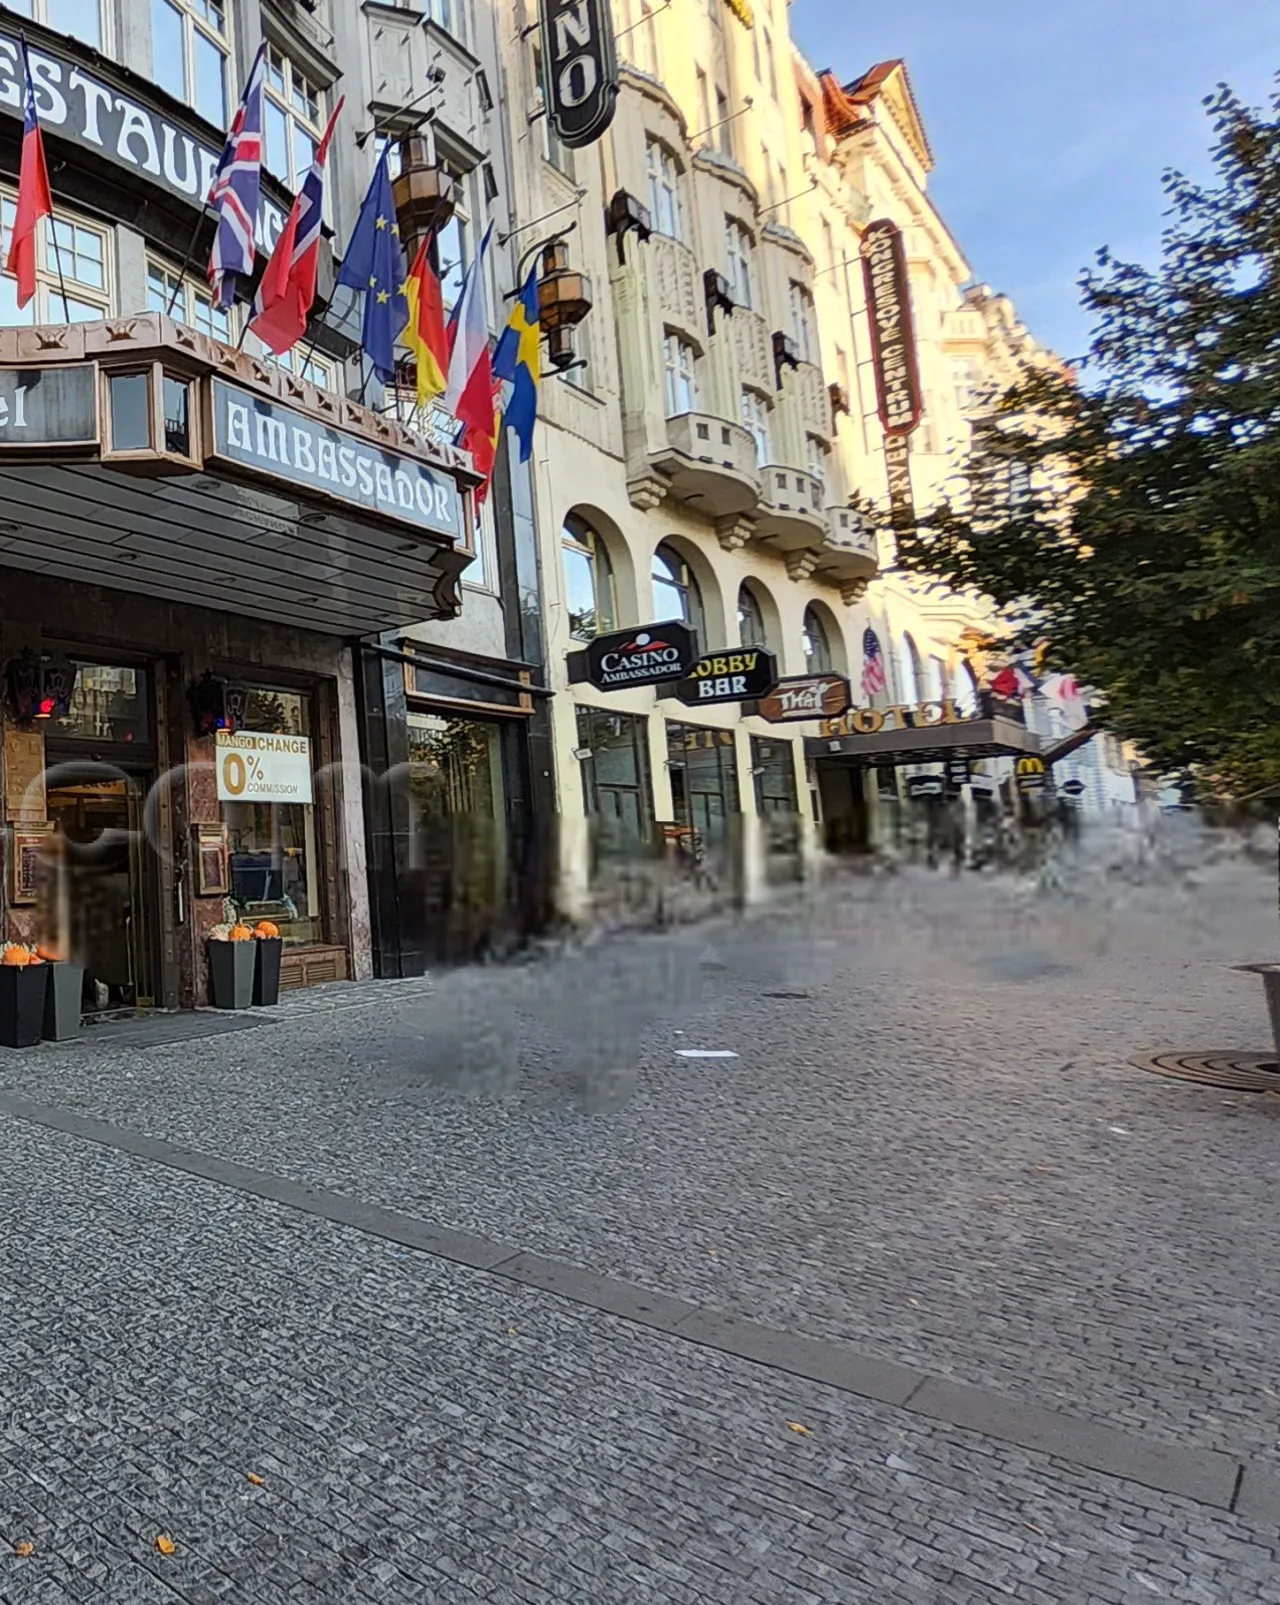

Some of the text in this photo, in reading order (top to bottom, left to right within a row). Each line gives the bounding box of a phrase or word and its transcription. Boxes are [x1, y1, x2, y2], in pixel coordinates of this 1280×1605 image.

[227, 400, 452, 523] AMBASSADOR
[698, 676, 748, 698] BAR
[217, 734, 307, 754] MANGO CHANGE
[223, 752, 264, 796] 0%
